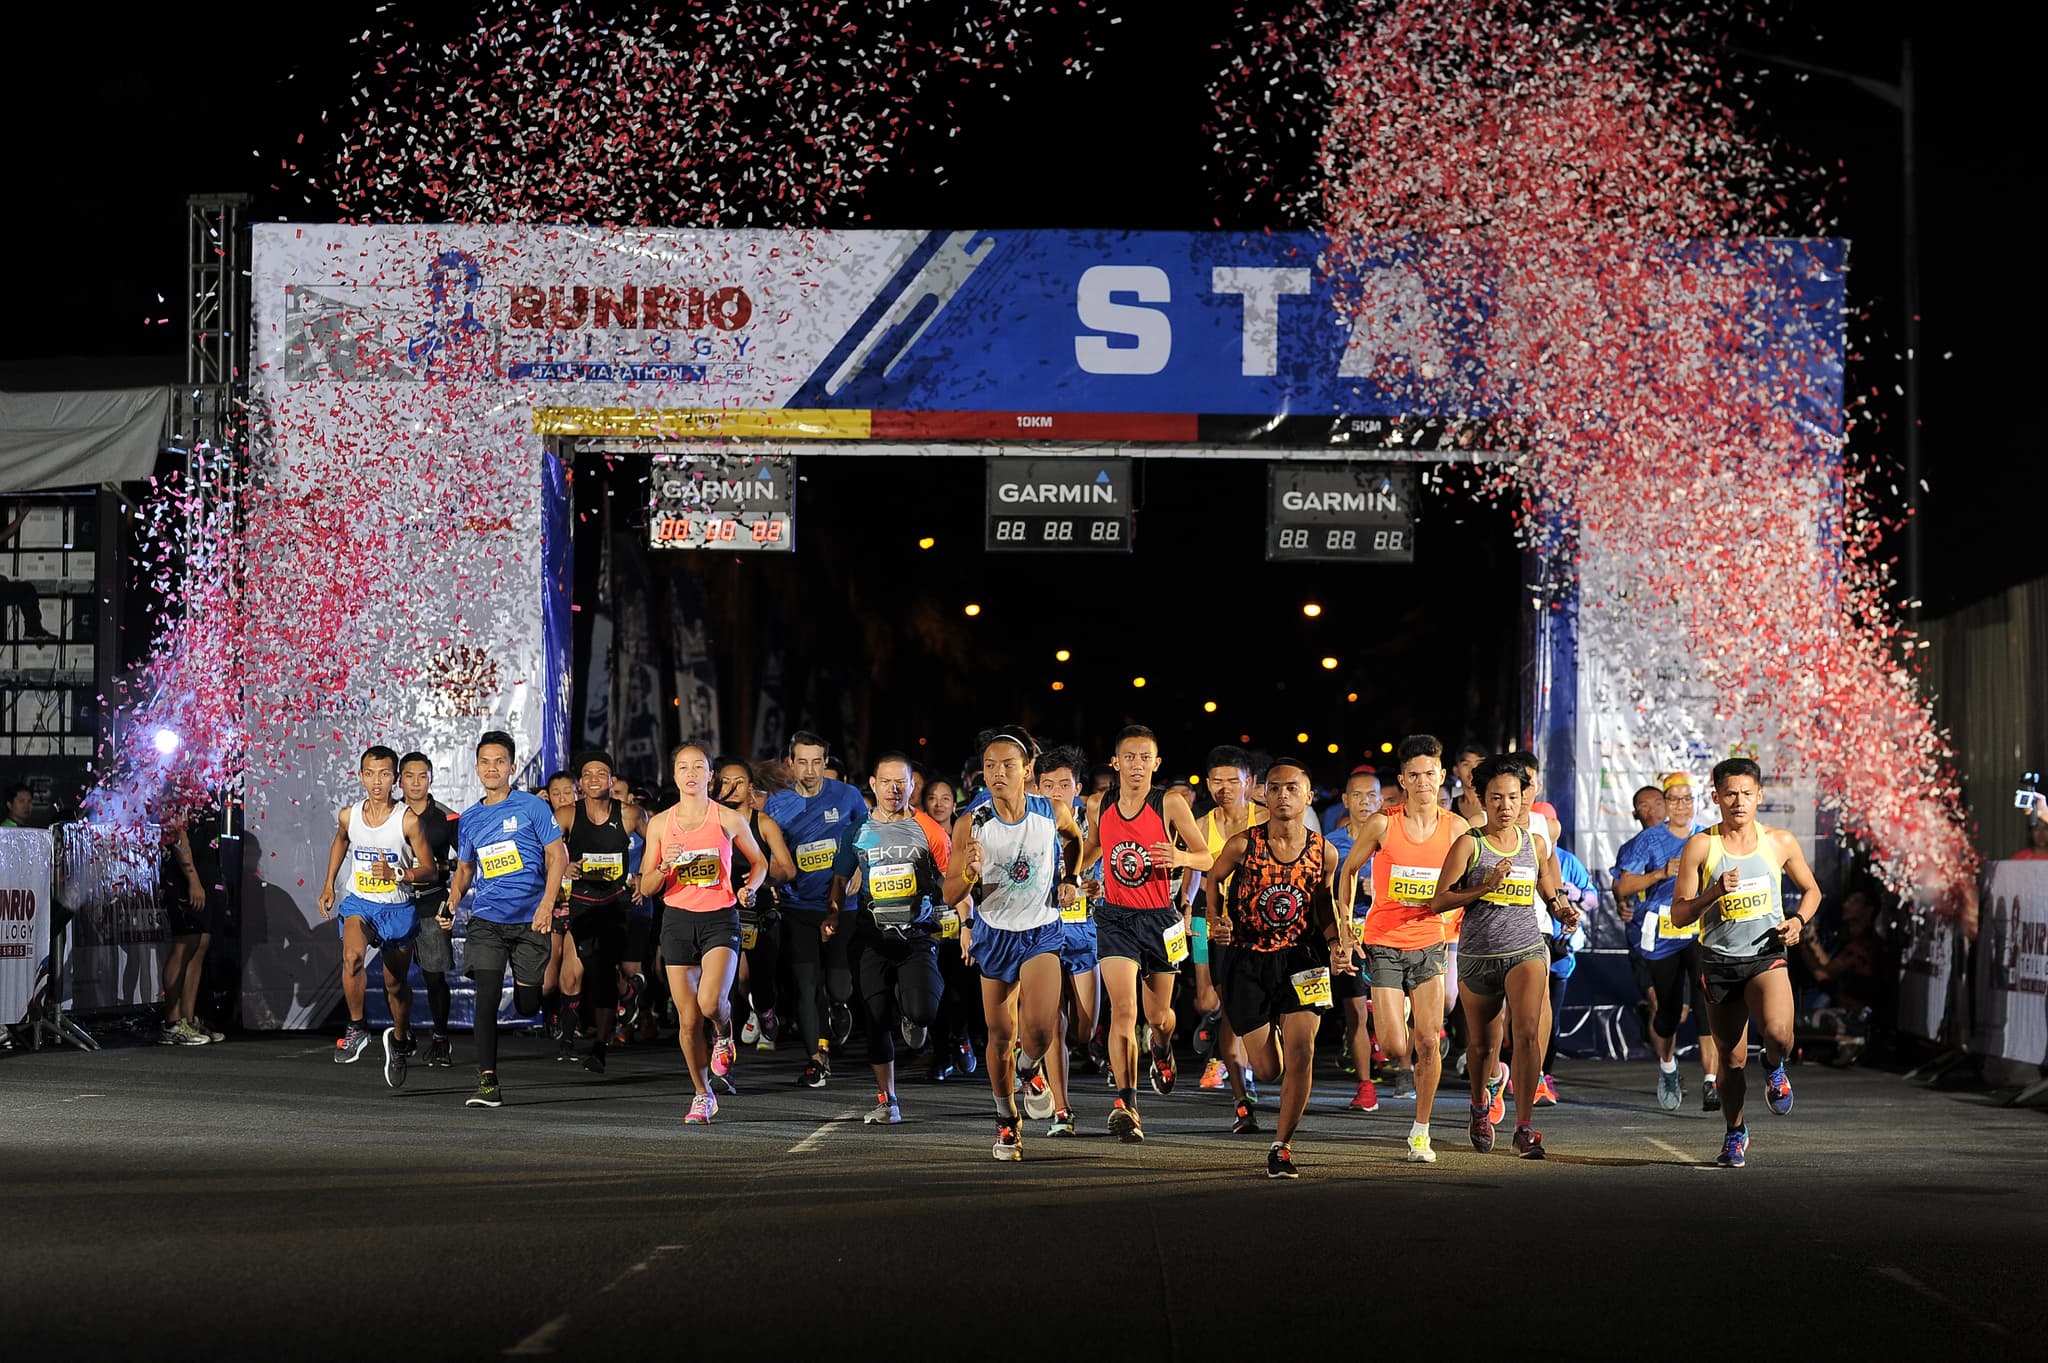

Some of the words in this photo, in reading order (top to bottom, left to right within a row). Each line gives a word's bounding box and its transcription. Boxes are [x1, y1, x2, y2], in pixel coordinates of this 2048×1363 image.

[508, 285, 752, 331] RUNRIO
[531, 365, 577, 380] HALF
[583, 366, 684, 382] MARATHON
[1016, 416, 1053, 428] 10KM
[1351, 420, 1381, 432] 5KM
[662, 480, 774, 501] GARMIN
[998, 483, 1114, 504] GARMIN
[1282, 491, 1398, 512] GARMIN
[1110, 842, 1136, 865] GUERILLA
[485, 854, 516, 871] 21263
[677, 863, 716, 880] 21252
[875, 878, 912, 893] 21358
[1394, 881, 1435, 896] 21543
[1493, 883, 1532, 897] 2069
[1724, 893, 1768, 912] 22067
